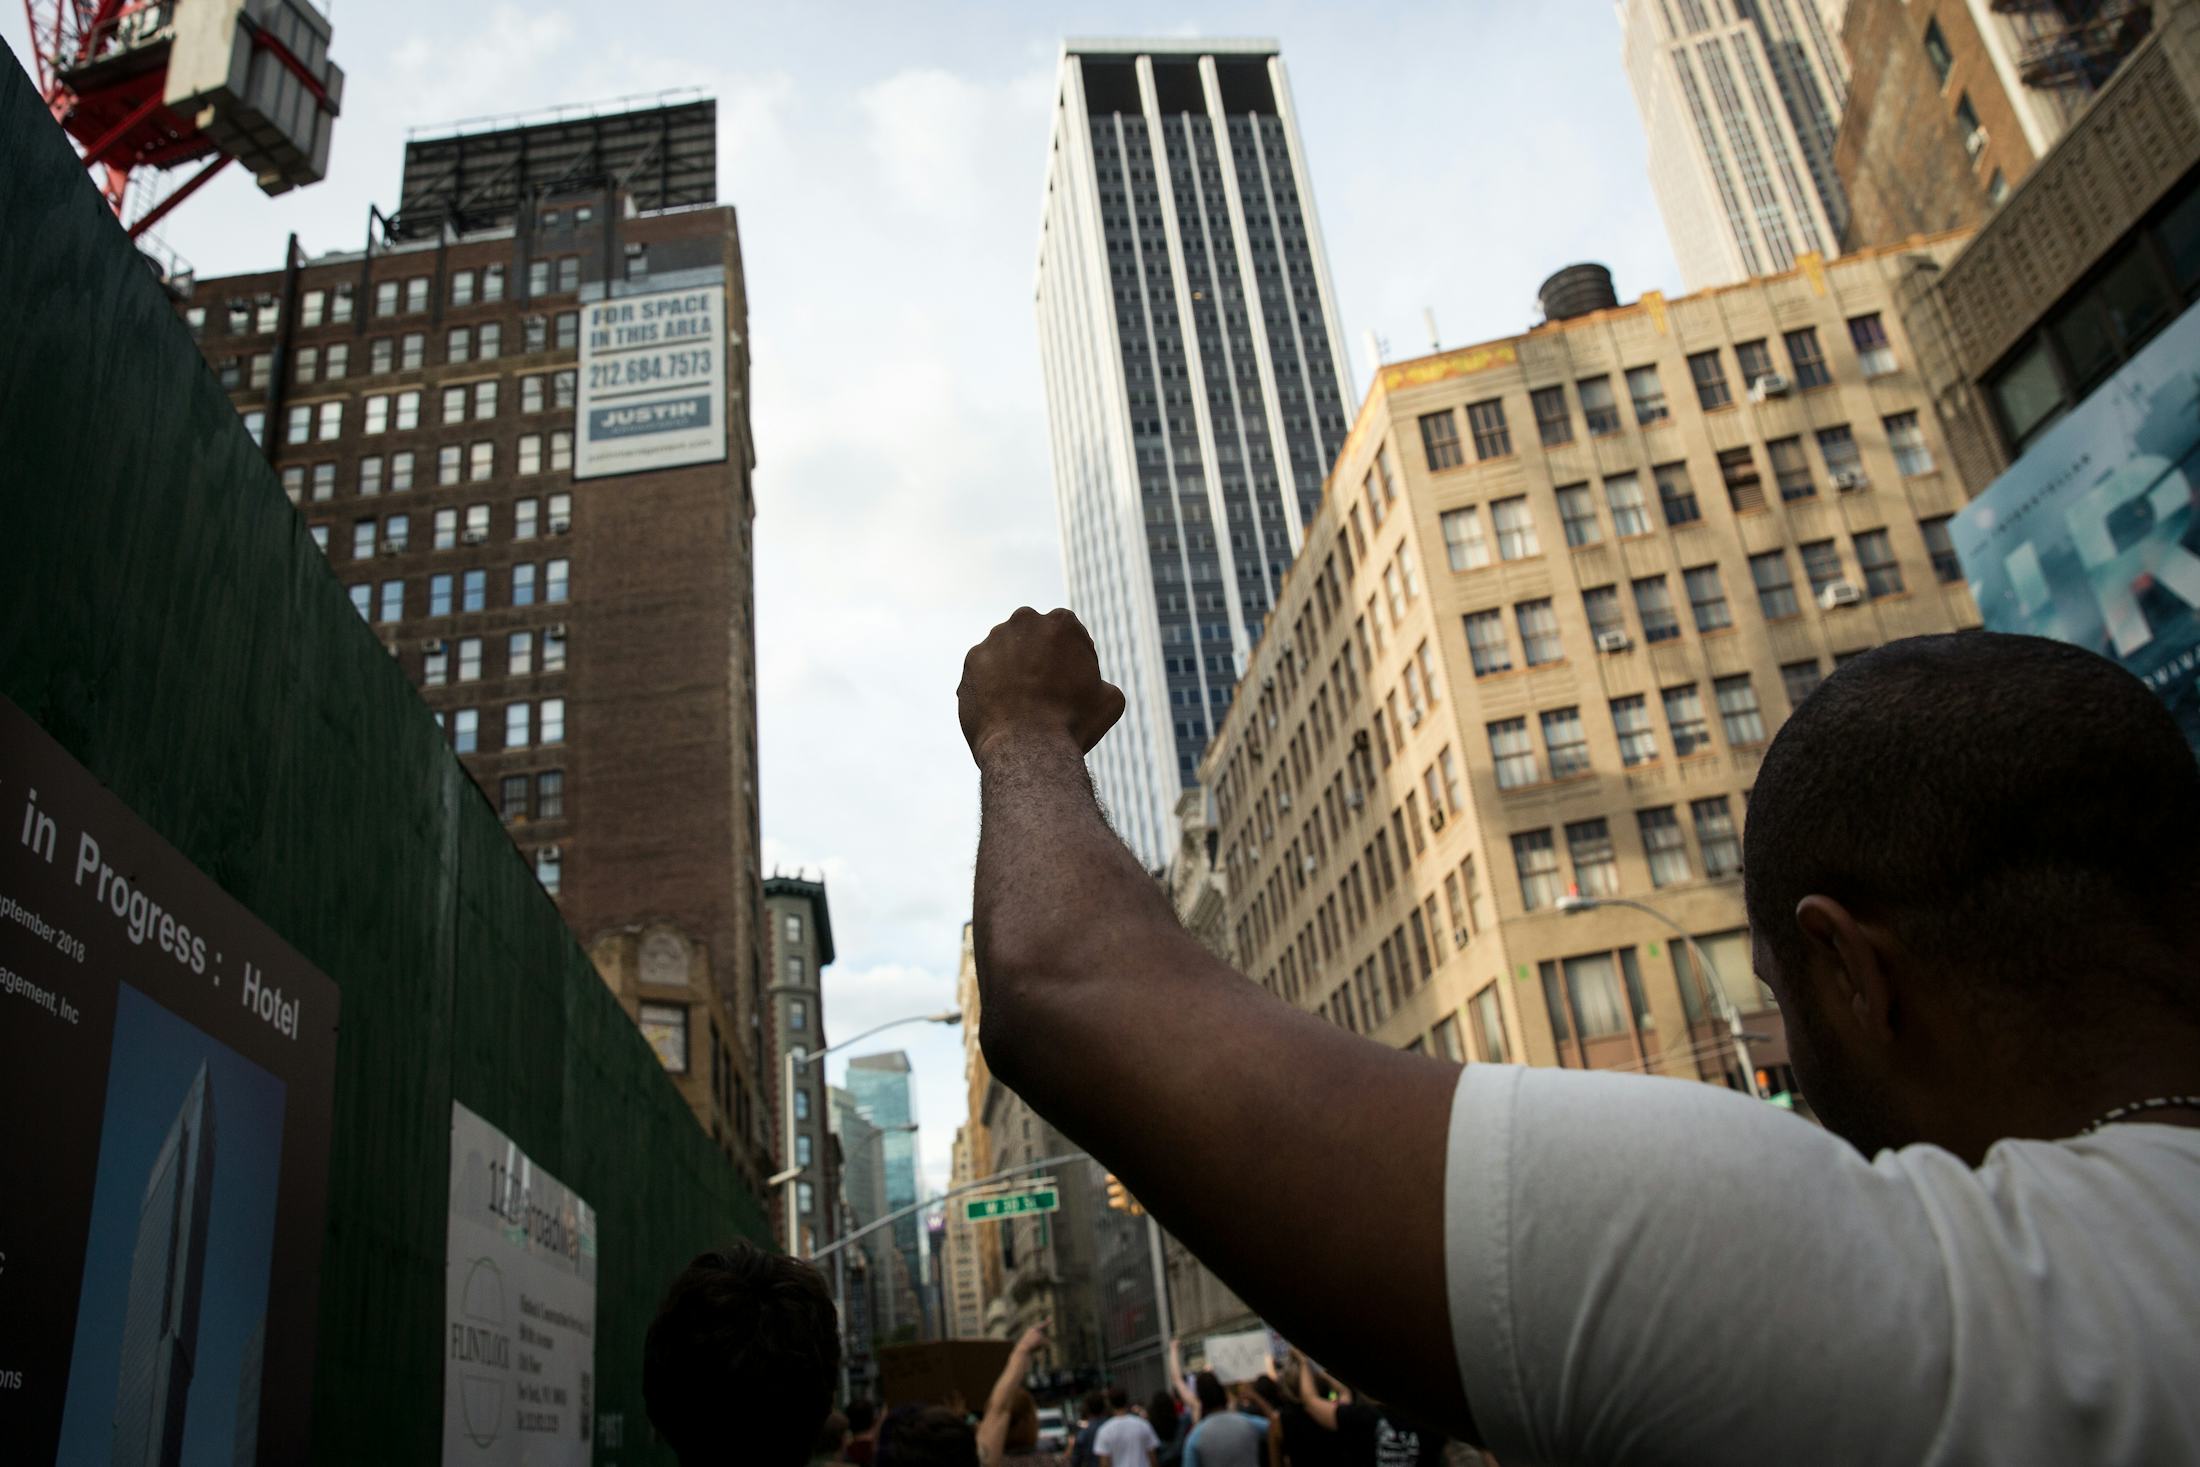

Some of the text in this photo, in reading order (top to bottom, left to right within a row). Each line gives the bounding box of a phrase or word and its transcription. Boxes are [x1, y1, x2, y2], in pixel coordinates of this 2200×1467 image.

[593, 293, 710, 326] FOR SPACE
[591, 316, 711, 348] IN THIS AREA
[589, 350, 712, 389] 212.684.7573
[601, 401, 697, 428] JUSTIN
[0, 893, 85, 964] ptember 2018
[21, 788, 57, 863] in
[242, 962, 299, 1040] Hotel
[60, 996, 79, 1025] Inc
